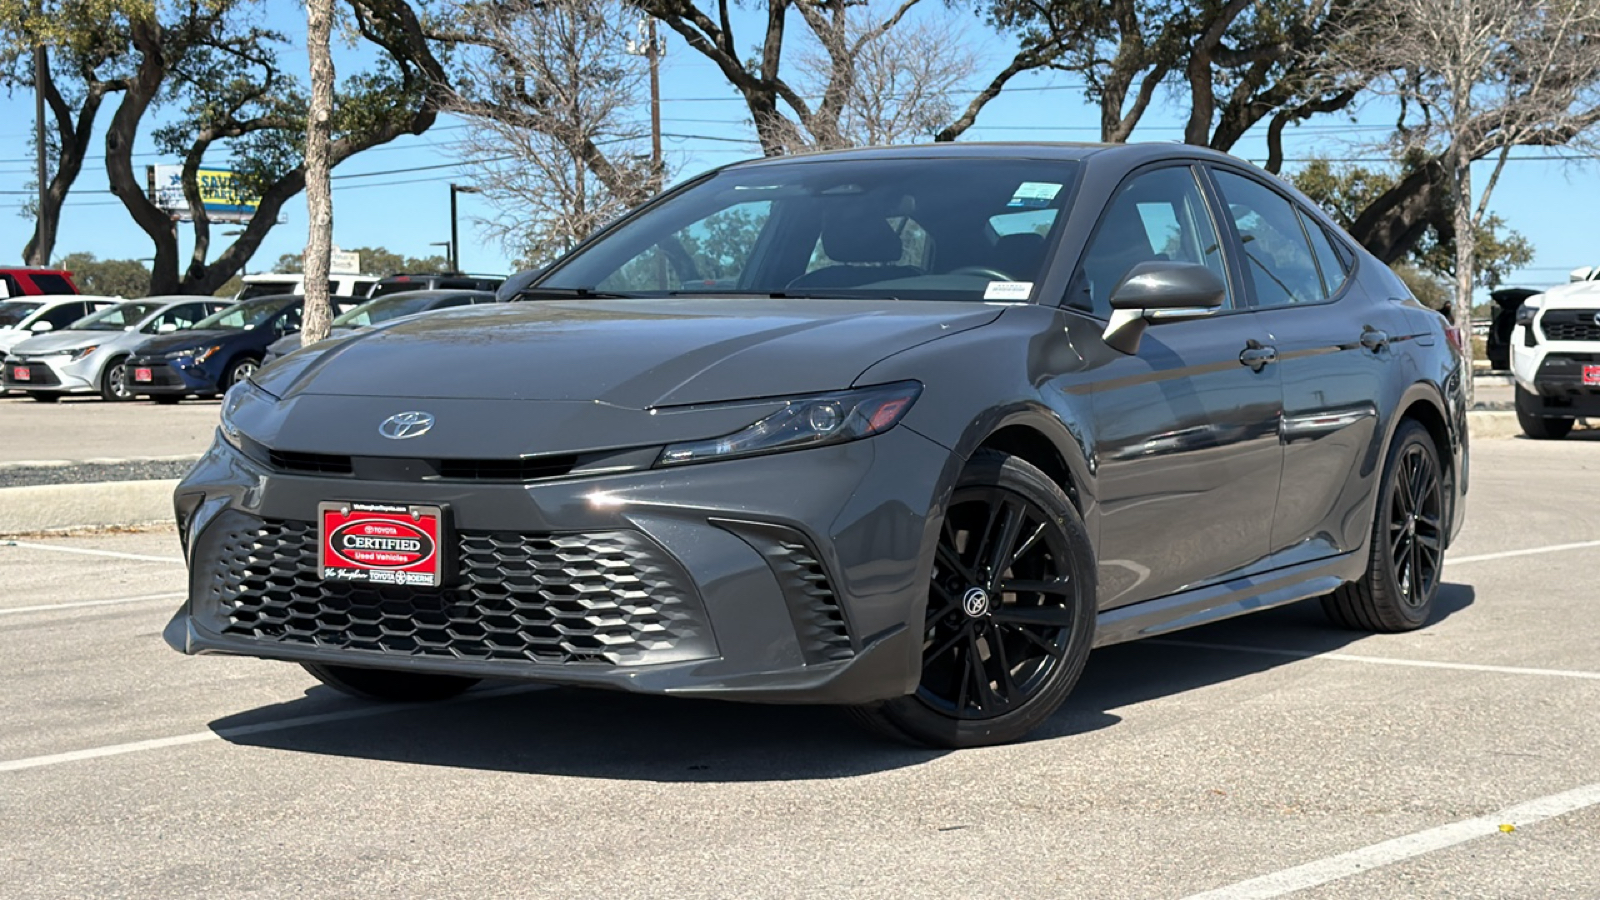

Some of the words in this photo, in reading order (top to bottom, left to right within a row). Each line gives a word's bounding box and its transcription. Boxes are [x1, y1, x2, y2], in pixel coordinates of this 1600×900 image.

[355, 552, 374, 561] Used
[376, 553, 408, 562] Vehicles
[407, 574, 434, 583] BOERNE
